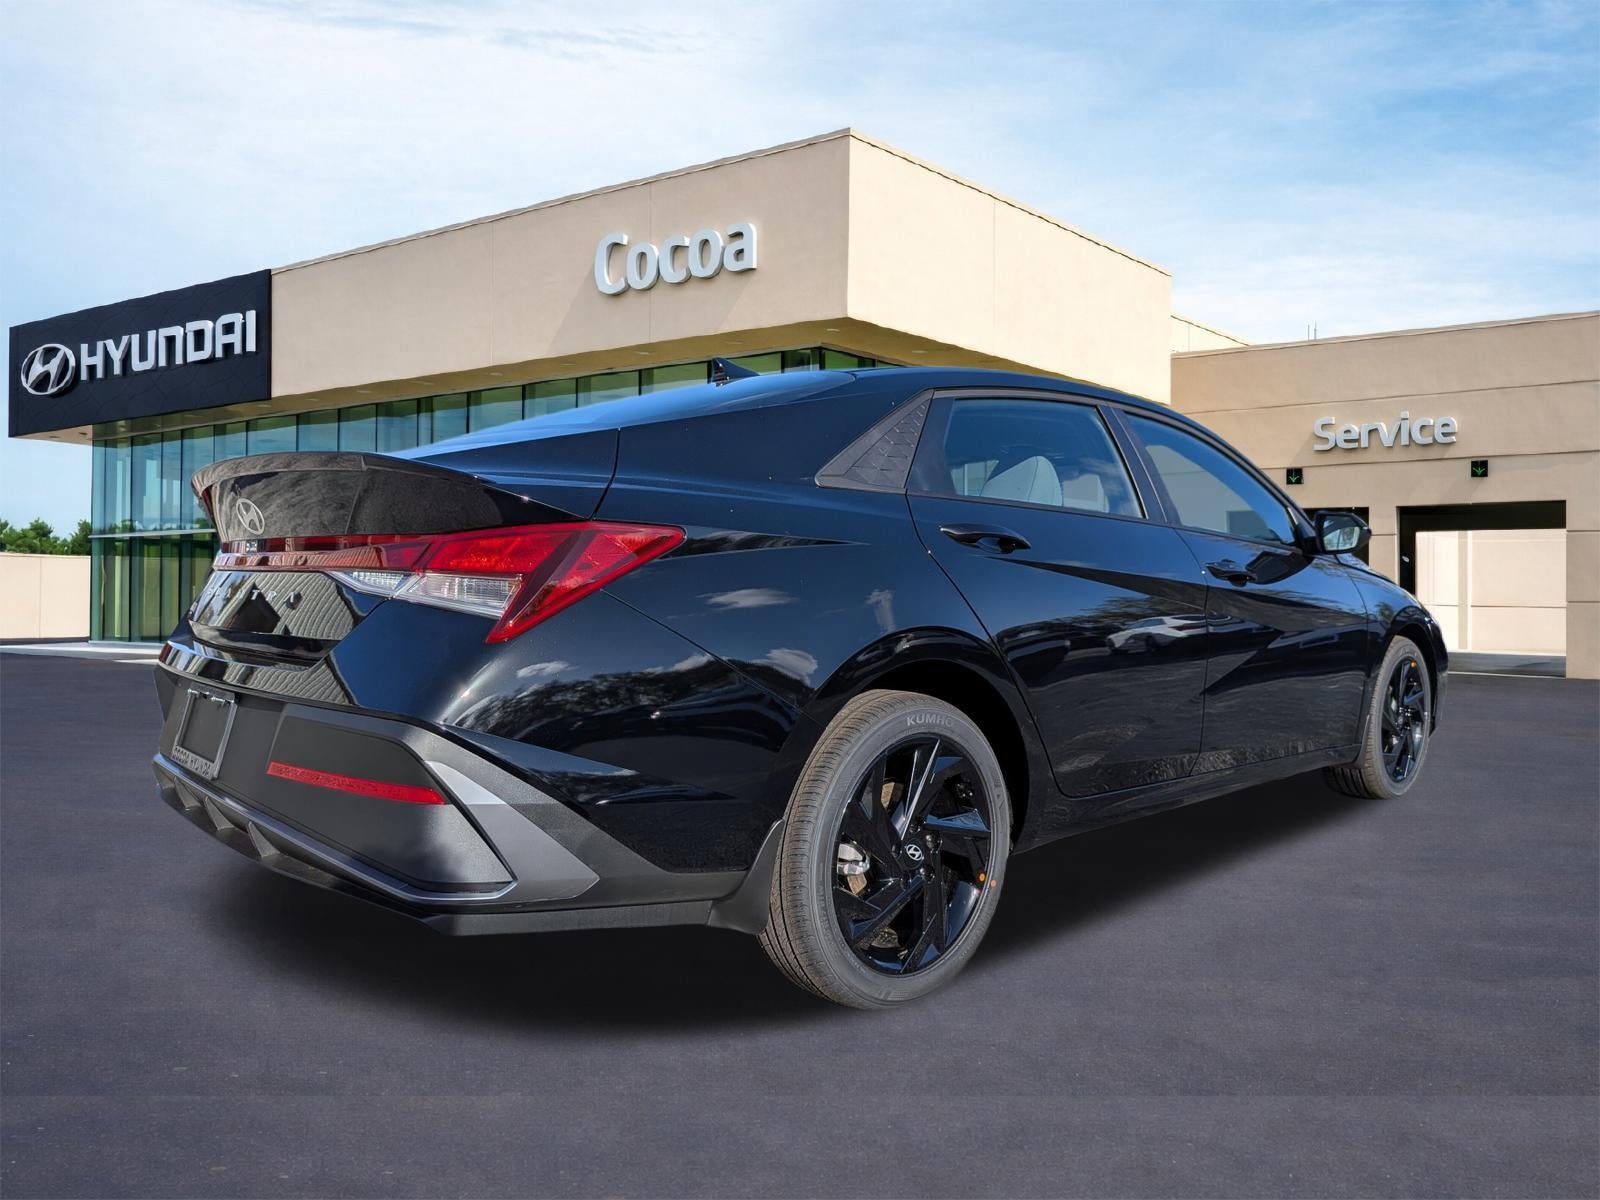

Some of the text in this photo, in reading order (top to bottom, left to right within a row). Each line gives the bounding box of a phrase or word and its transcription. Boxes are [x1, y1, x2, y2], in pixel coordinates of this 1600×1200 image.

[594, 222, 757, 295] Cocoa
[80, 310, 257, 381] HYUNDAI
[1313, 411, 1458, 451] Service
[907, 713, 954, 727] KUMHO
